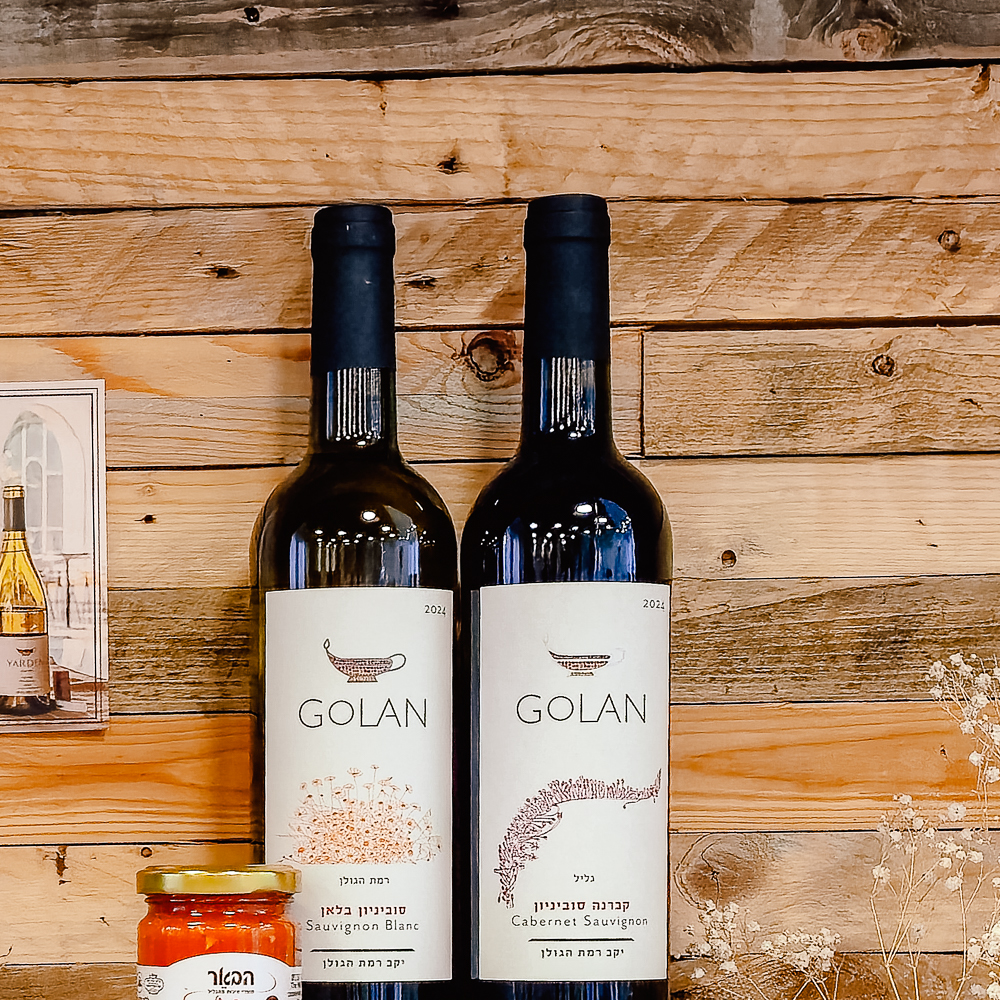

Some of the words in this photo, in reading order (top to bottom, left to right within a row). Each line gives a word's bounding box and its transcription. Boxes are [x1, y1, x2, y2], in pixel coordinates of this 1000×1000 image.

[424, 604, 447, 617] 2024
[643, 599, 665, 613] 2024
[298, 698, 427, 728] GOLAN
[515, 693, 647, 724] GOLAN
[339, 876, 365, 887] הגולן
[369, 876, 390, 885] רמת
[573, 874, 595, 883] גליל
[320, 905, 352, 918] בלאן
[358, 906, 407, 918] סוביניון
[534, 901, 586, 913] סוביניון
[592, 901, 630, 913] קברנה
[306, 919, 379, 936] Sauvignon
[385, 919, 419, 931] Blanc
[511, 914, 577, 927] Cabernet
[583, 914, 648, 930] Sauvignon
[541, 947, 573, 959] הגולן
[577, 948, 602, 958] רמת
[606, 948, 624, 959] יקב
[322, 958, 354, 969] הגולן
[358, 959, 382, 968] רמת
[387, 958, 405, 969] יקב
[208, 967, 254, 987] הבאר
